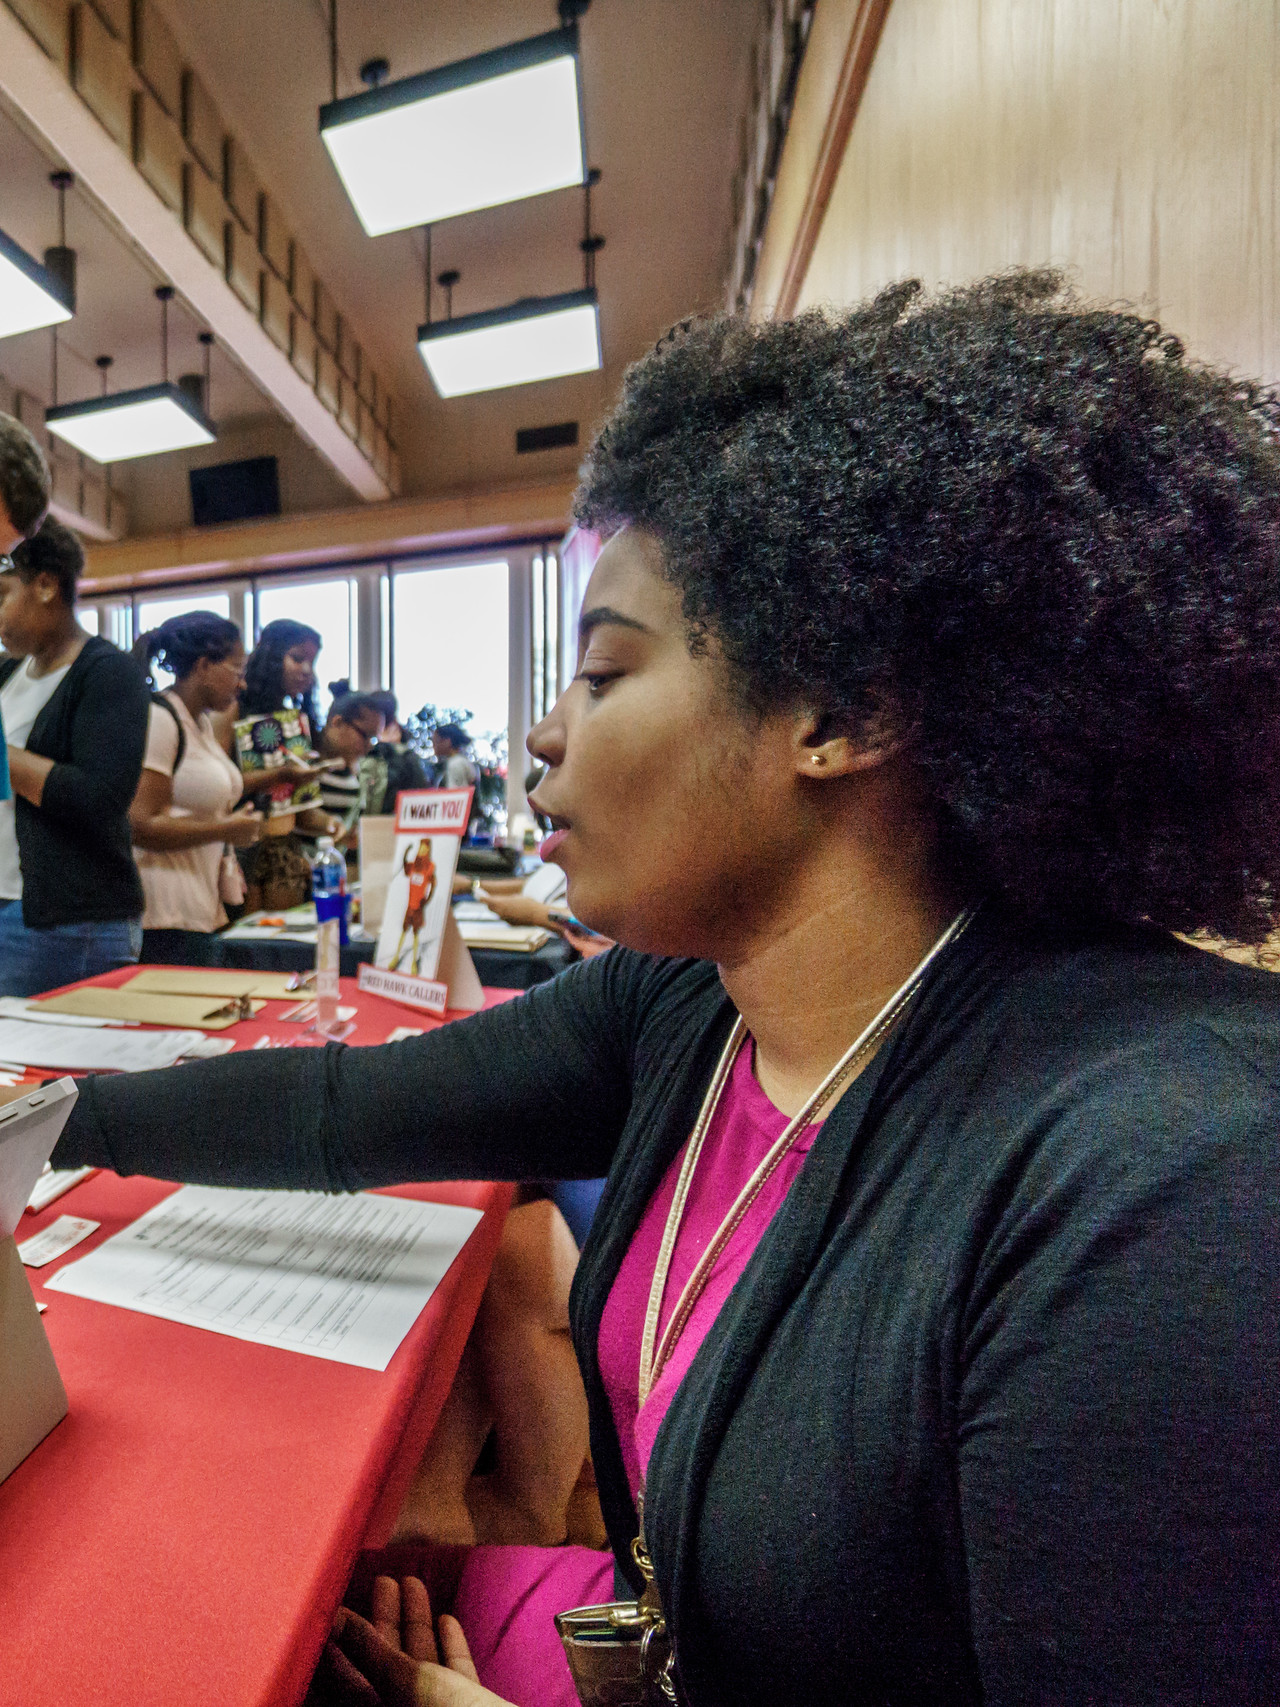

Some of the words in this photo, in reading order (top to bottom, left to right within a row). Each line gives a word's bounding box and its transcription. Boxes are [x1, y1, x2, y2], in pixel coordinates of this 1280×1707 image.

[410, 802, 439, 820] WANT
[442, 800, 464, 820] YOU
[384, 979, 407, 995] HAWK
[409, 984, 445, 1006] CALLERS
